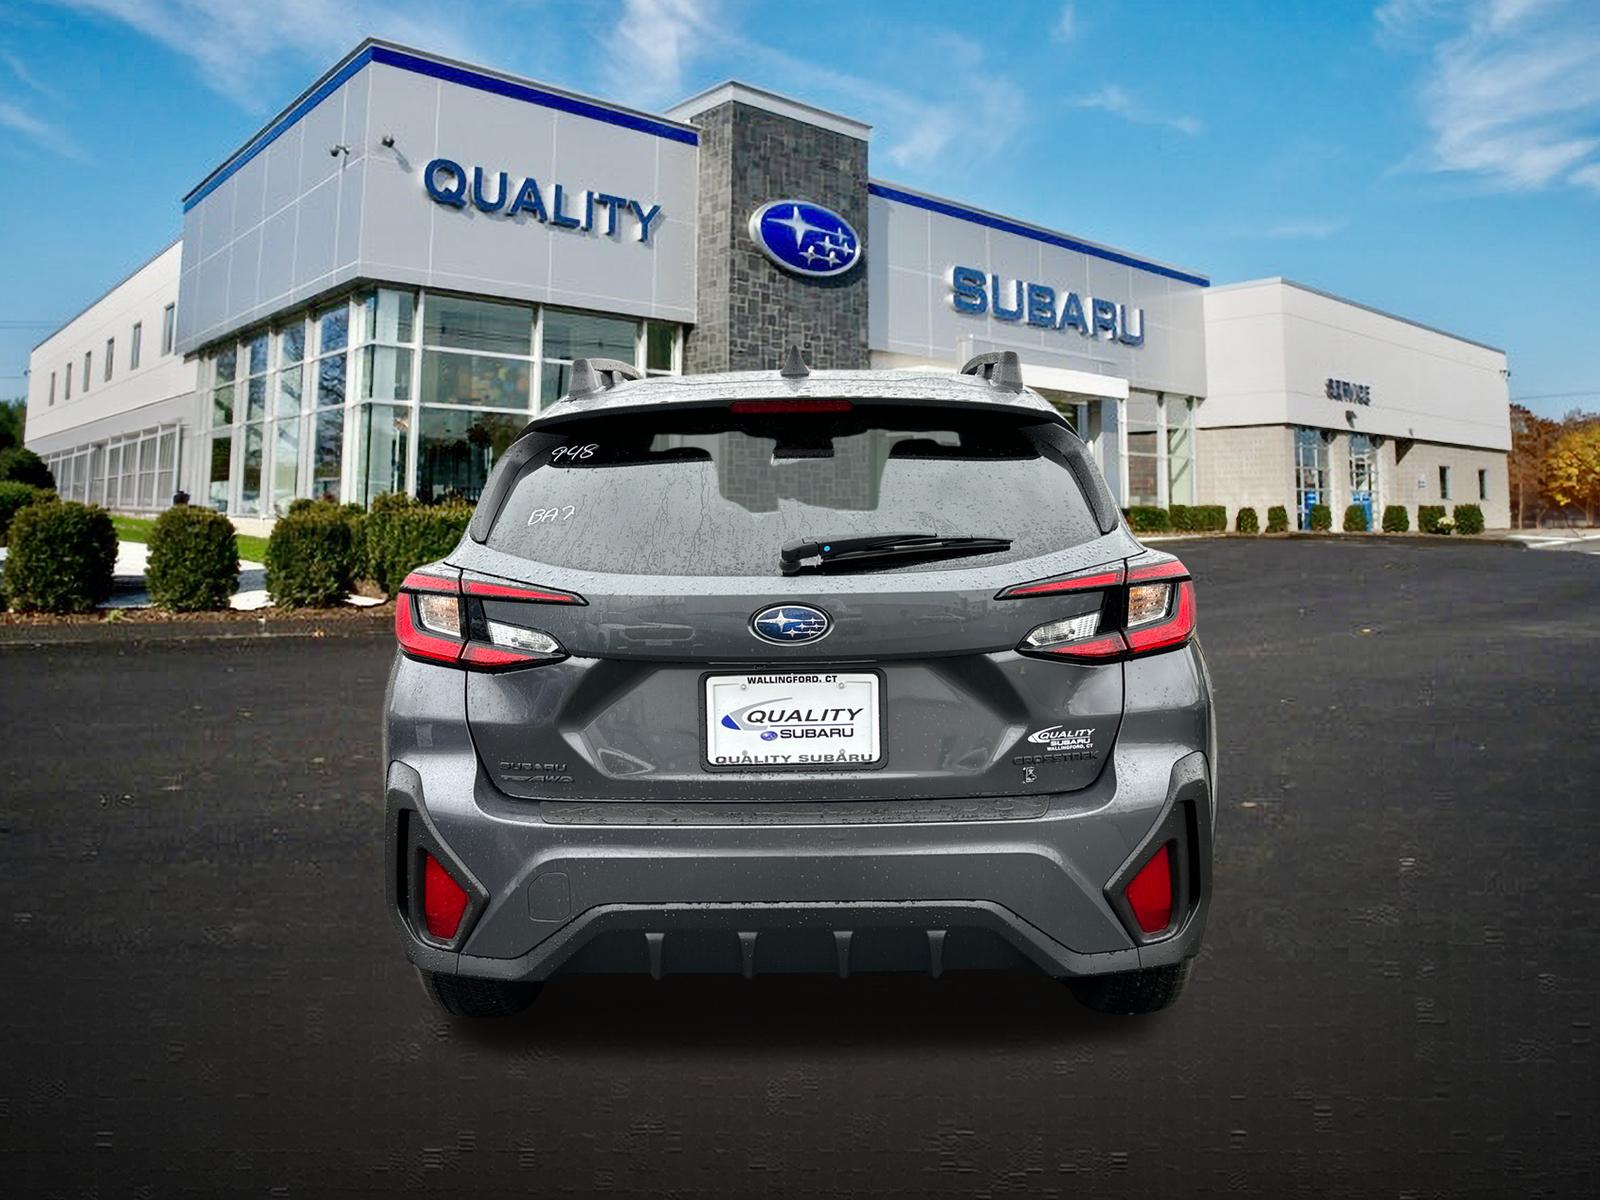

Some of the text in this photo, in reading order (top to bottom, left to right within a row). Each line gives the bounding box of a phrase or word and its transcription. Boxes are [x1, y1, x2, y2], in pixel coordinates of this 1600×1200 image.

[424, 158, 662, 242] QUALITY
[951, 265, 1145, 347] SUBARU
[551, 443, 600, 462] 948
[825, 675, 838, 683] CT
[747, 708, 864, 723] QUALITY
[780, 728, 854, 739] SUBARU
[1040, 729, 1096, 738] QUALITY
[1050, 738, 1091, 747] SUBARU
[715, 753, 873, 764] QUALITY SUBARU
[1013, 751, 1099, 765] CROSSTREK
[500, 761, 568, 771] SUBARU
